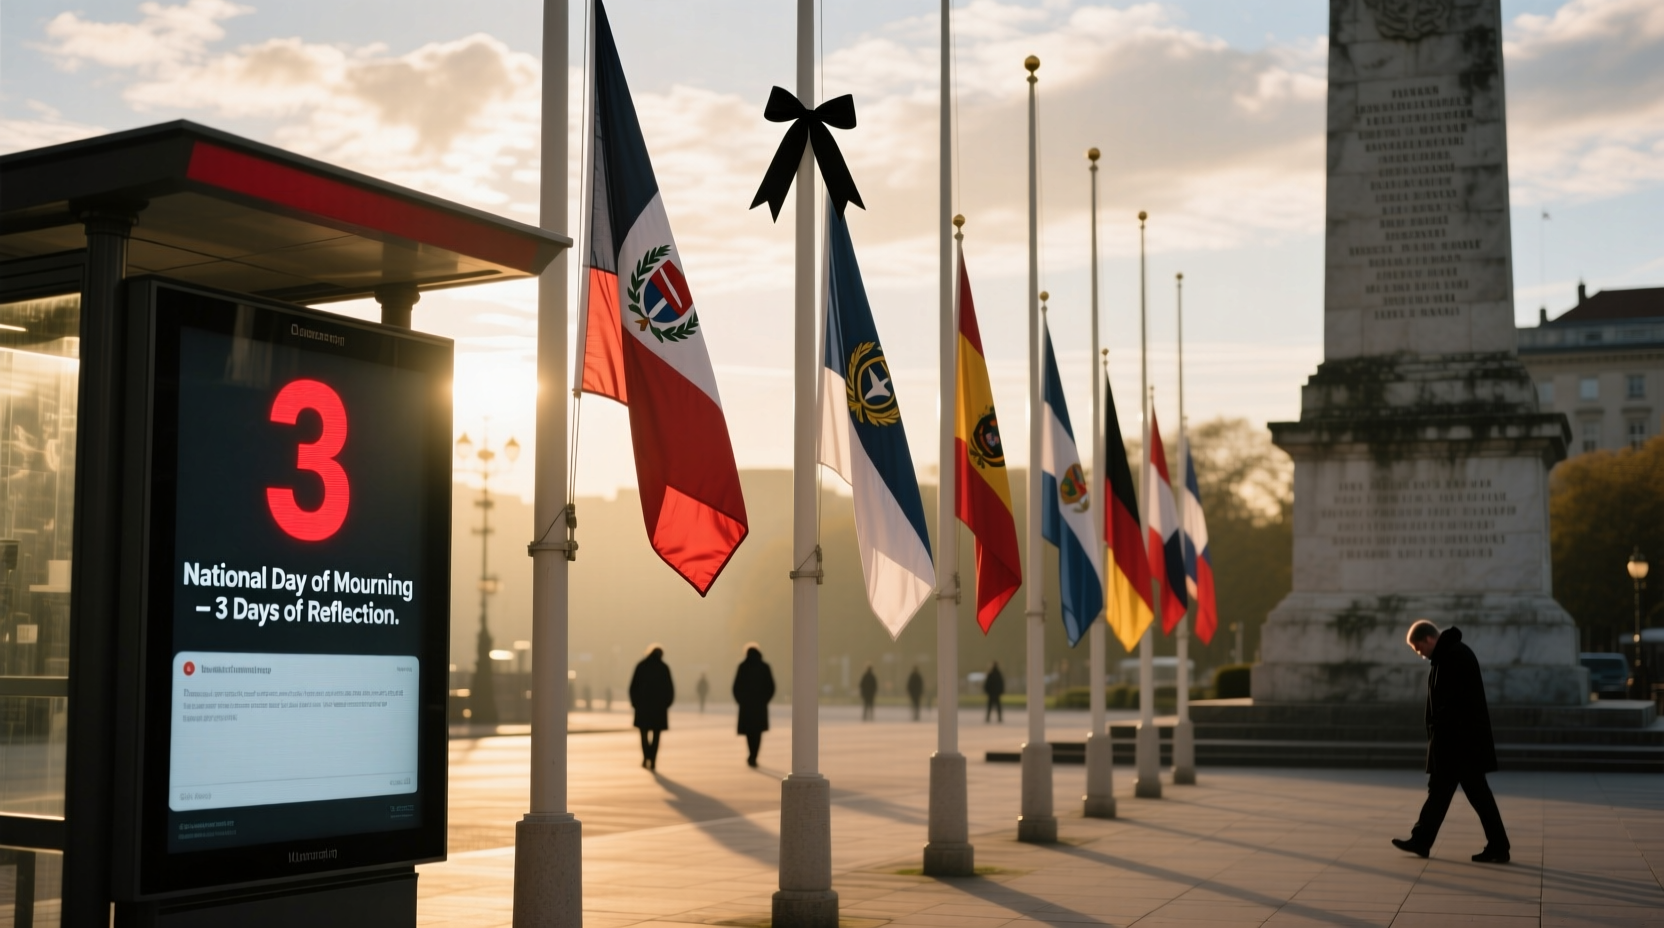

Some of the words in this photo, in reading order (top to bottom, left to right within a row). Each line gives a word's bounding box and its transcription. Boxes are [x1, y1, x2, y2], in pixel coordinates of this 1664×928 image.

[266, 378, 350, 542] 3
[183, 561, 267, 589] National
[271, 567, 308, 597] Day
[311, 569, 331, 593] of
[333, 570, 413, 602] Mourning
[215, 596, 229, 620] 3
[233, 596, 280, 628] Days
[283, 598, 304, 622] of
[307, 599, 400, 625] Reflection.
